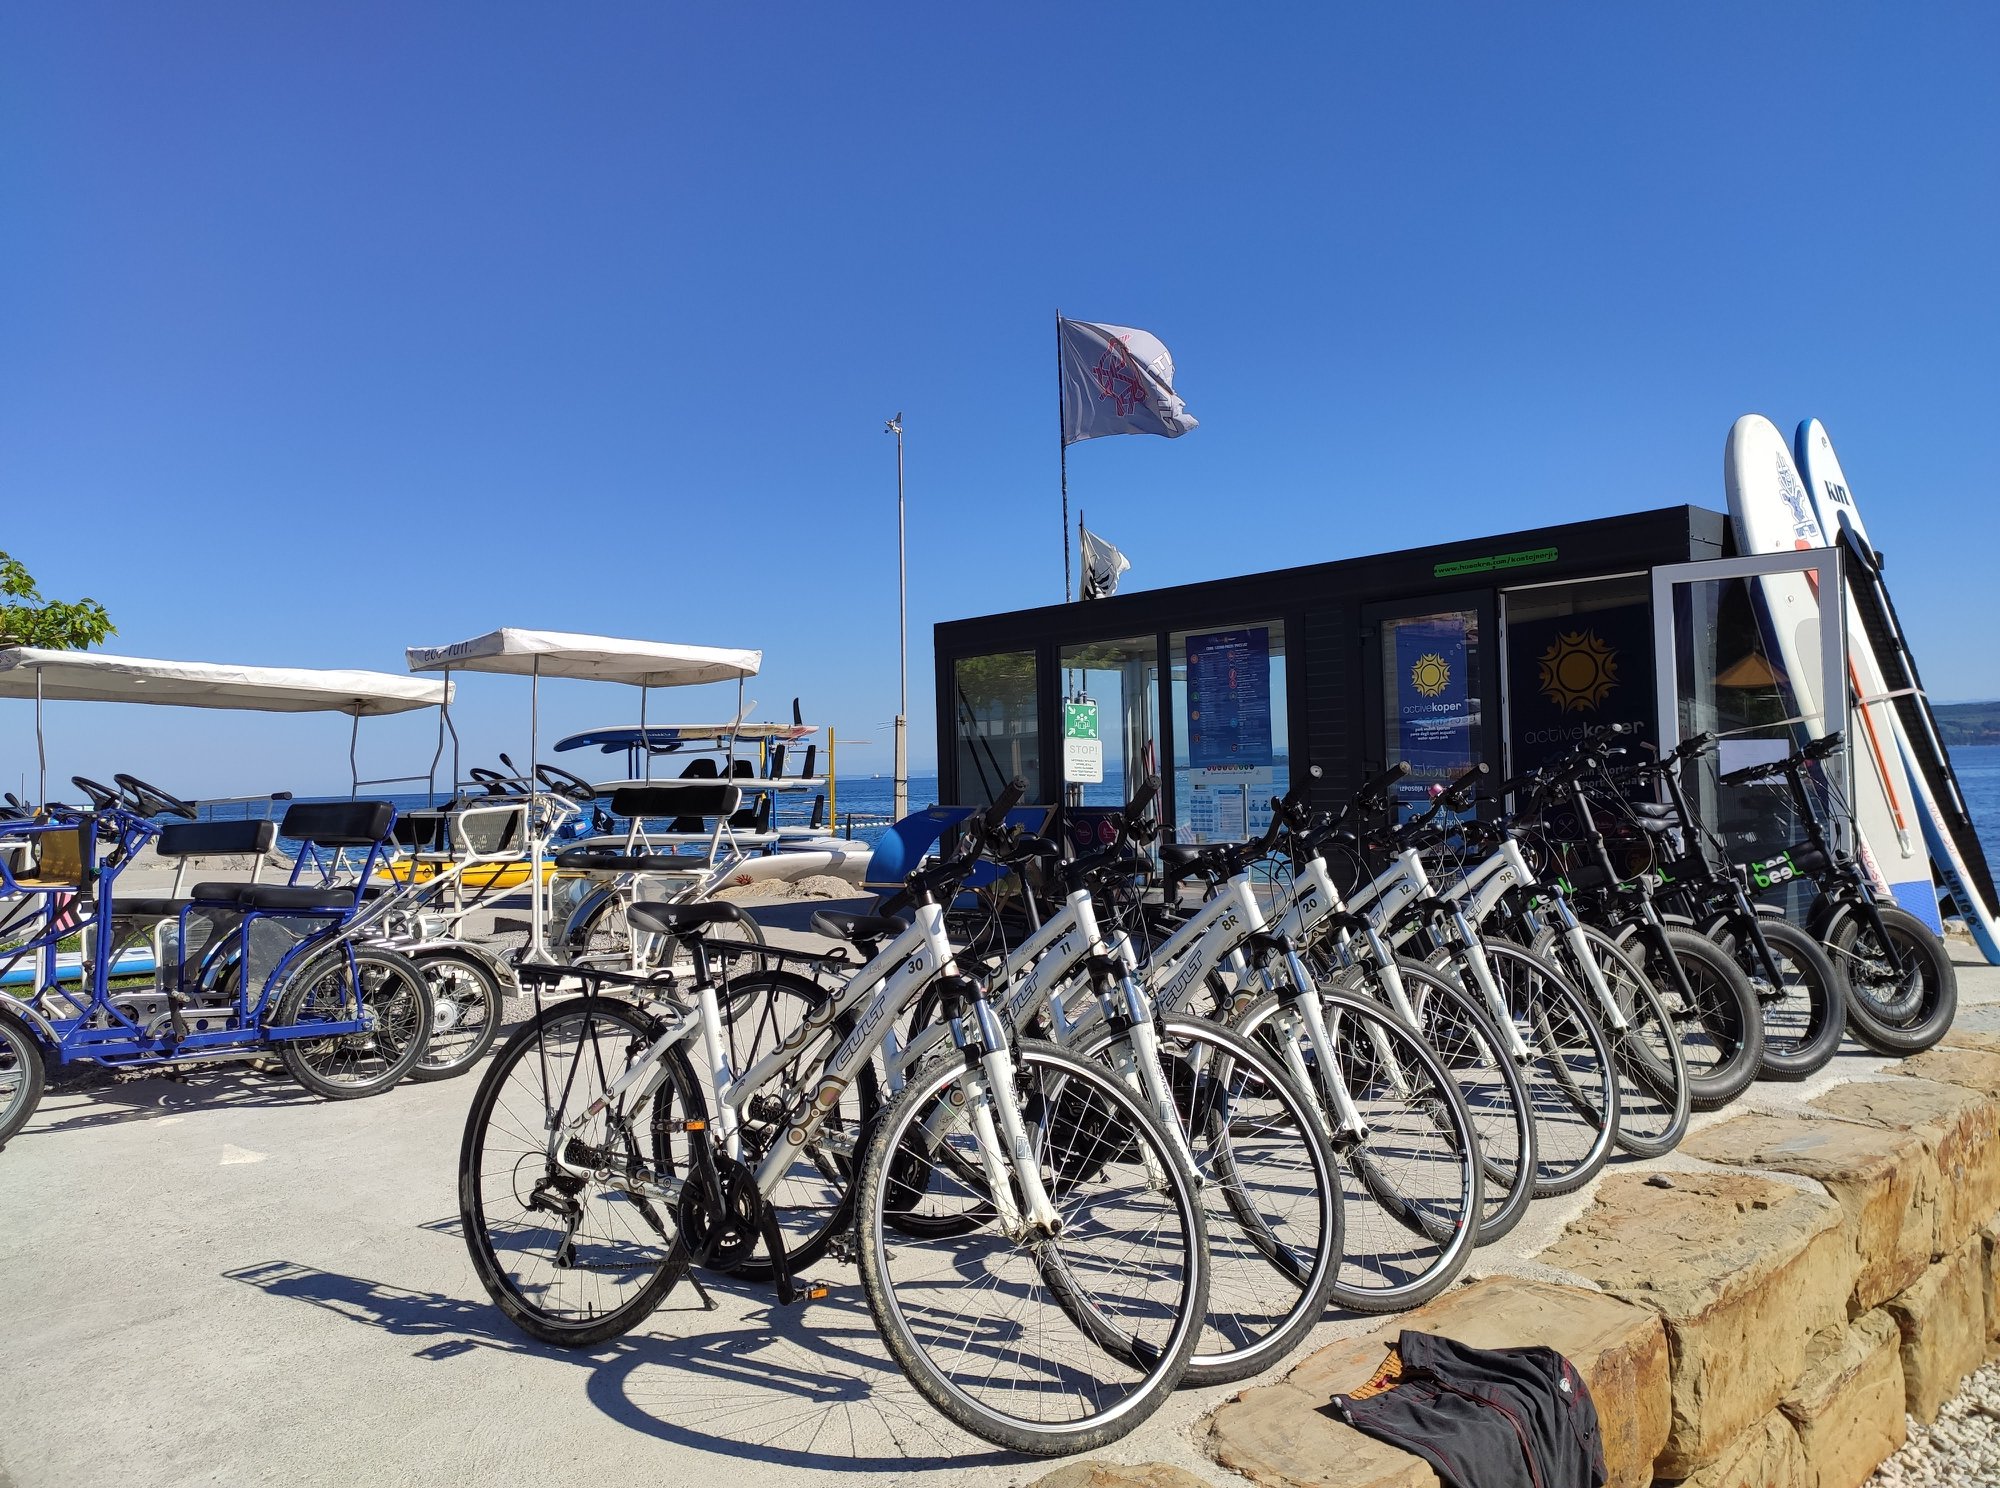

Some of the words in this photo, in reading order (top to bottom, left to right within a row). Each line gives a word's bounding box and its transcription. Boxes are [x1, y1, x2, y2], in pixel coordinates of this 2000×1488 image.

[1069, 745, 1098, 755] STOP!
[1499, 871, 1515, 886] 9R
[1399, 883, 1412, 898] 12
[1302, 898, 1318, 914] 20
[1221, 914, 1240, 932] 8R
[1060, 941, 1073, 956] 11
[907, 958, 924, 975] 30
